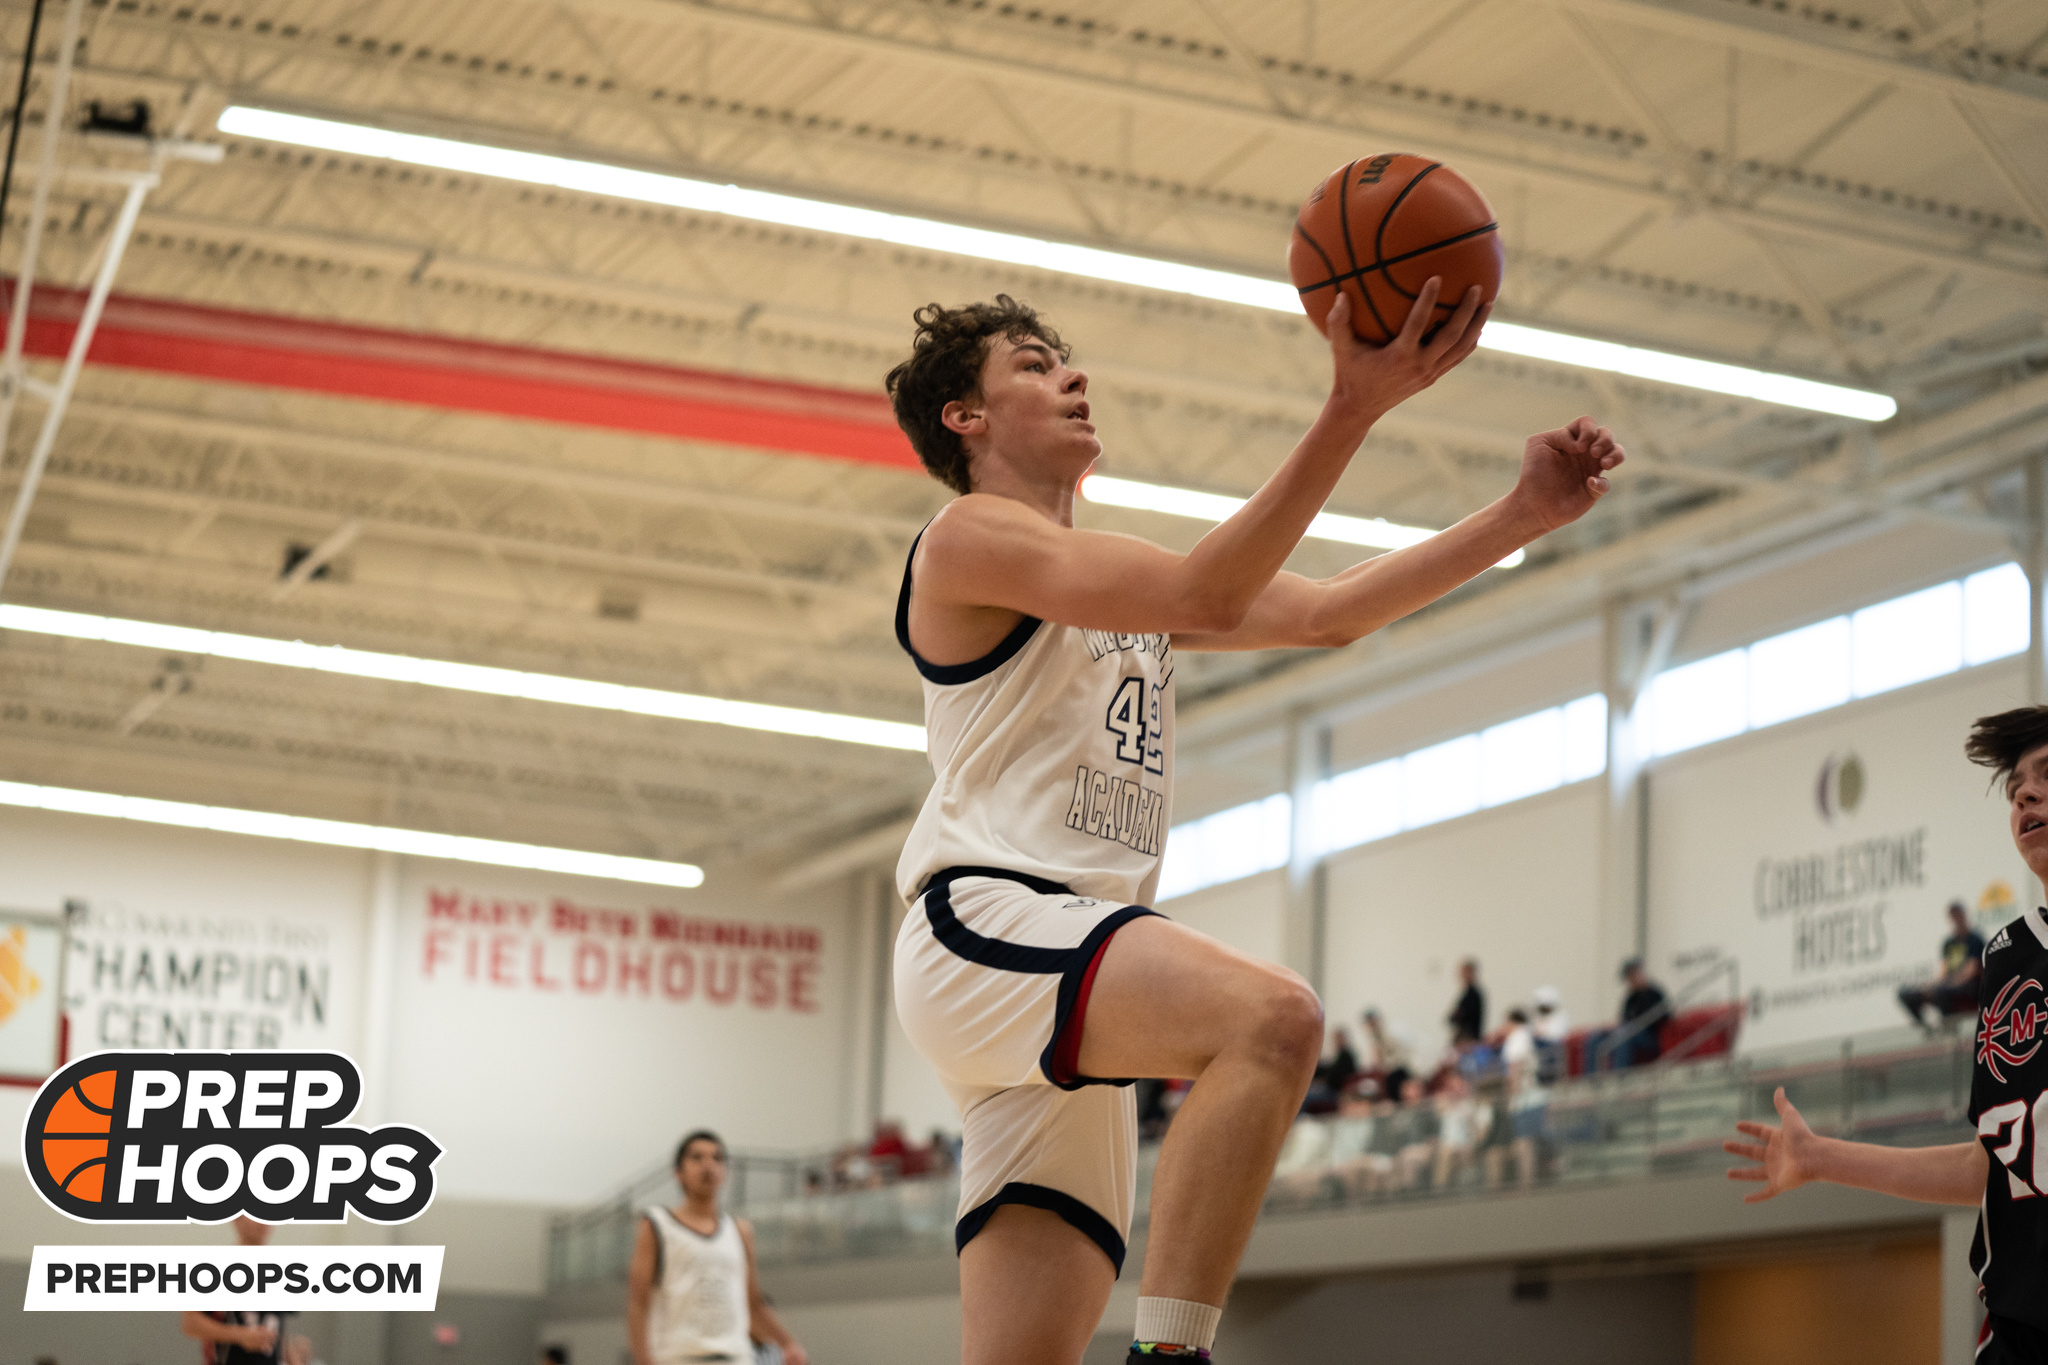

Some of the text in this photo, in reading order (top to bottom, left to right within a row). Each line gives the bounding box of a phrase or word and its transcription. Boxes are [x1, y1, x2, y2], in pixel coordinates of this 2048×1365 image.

[1106, 676, 1163, 776] 42
[422, 928, 821, 1013] FIELDHOUSE
[98, 1001, 283, 1050] CENTER
